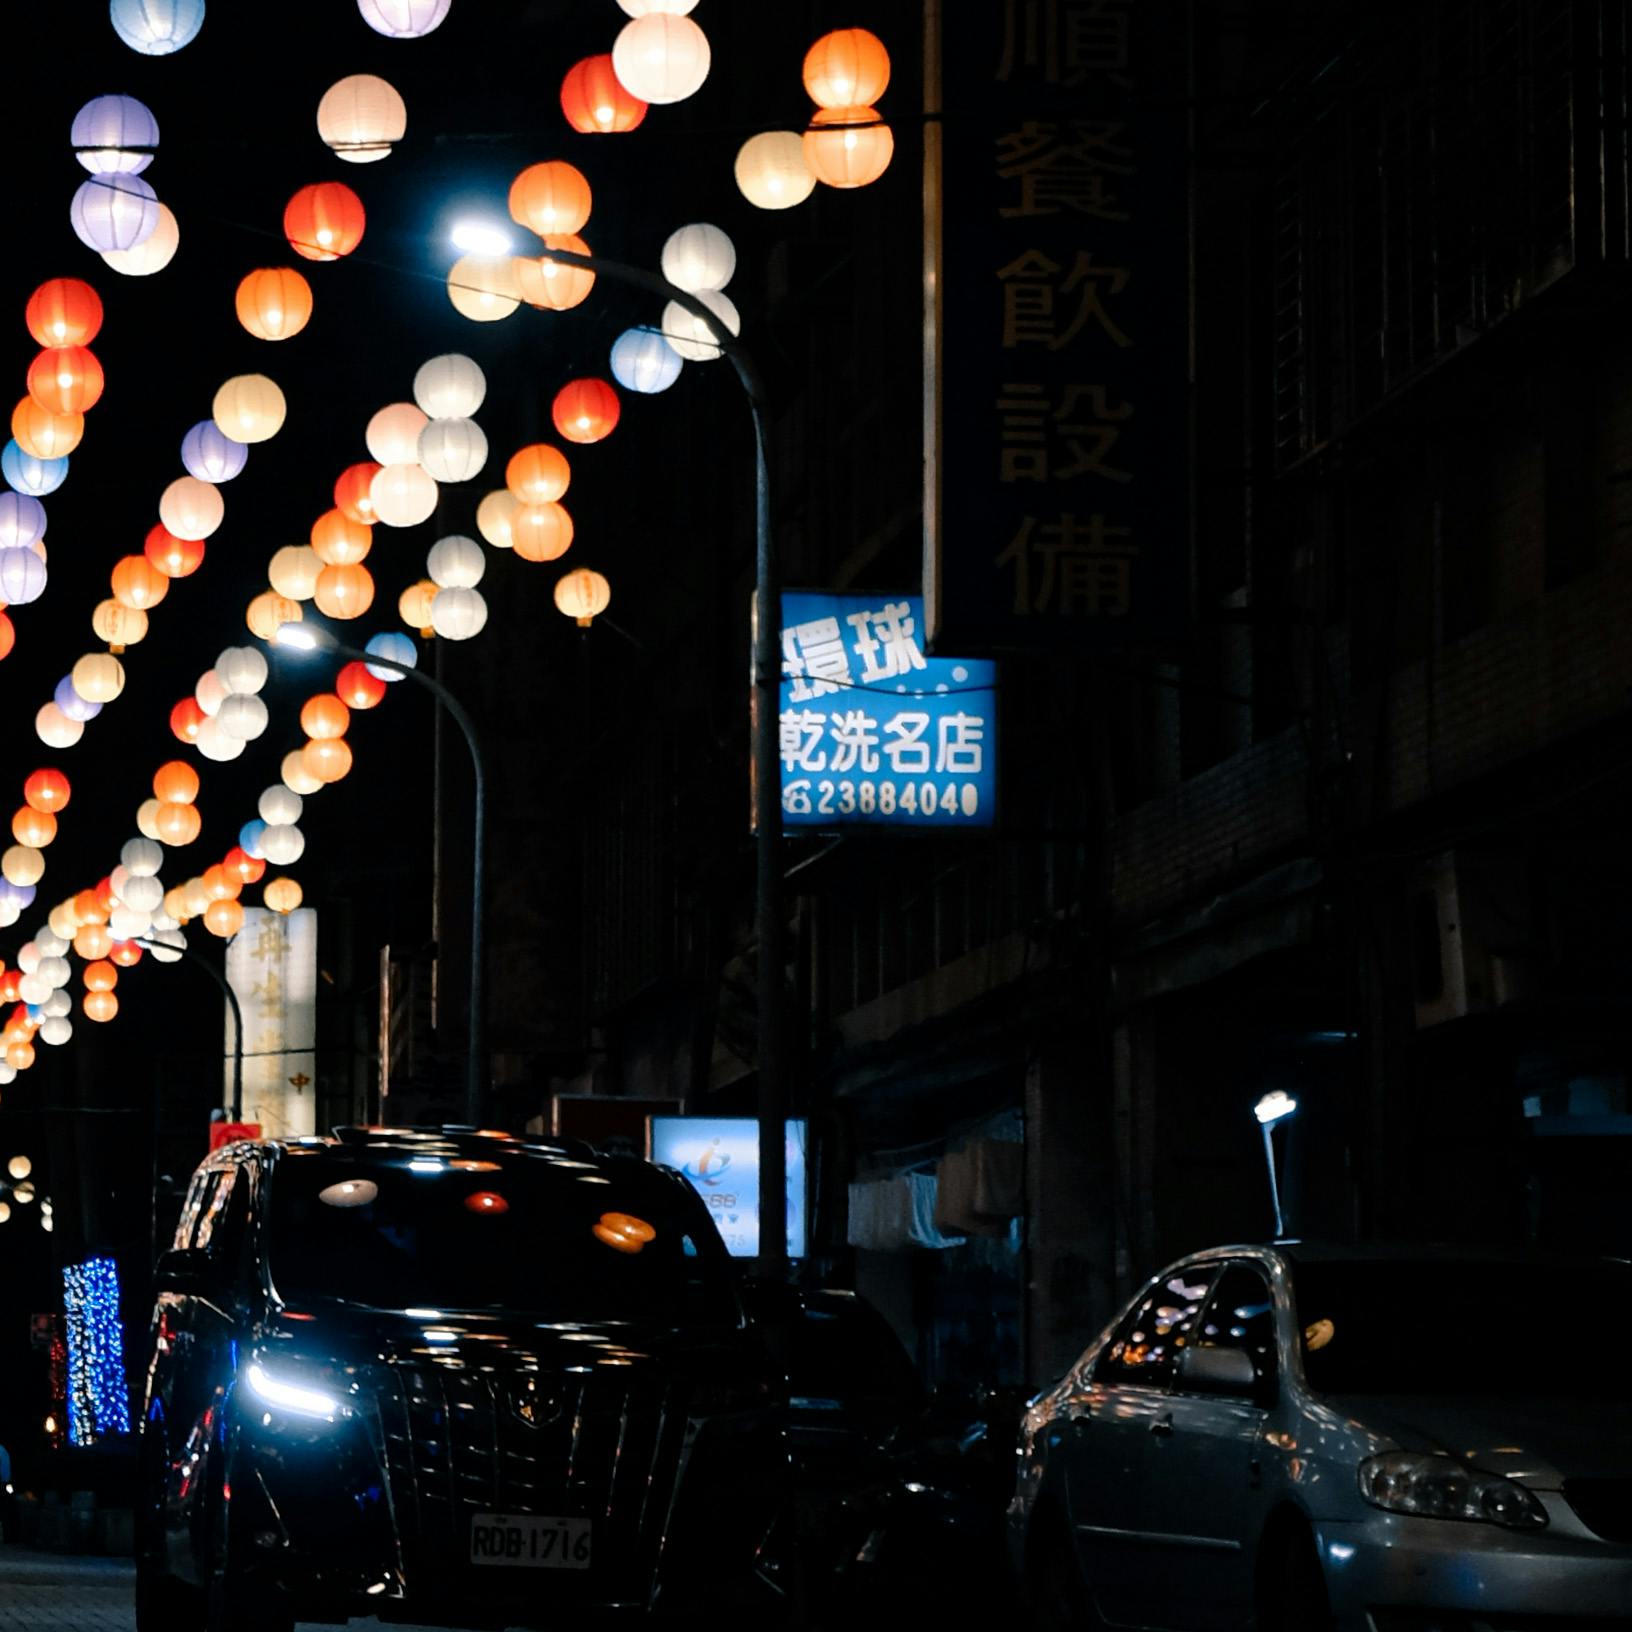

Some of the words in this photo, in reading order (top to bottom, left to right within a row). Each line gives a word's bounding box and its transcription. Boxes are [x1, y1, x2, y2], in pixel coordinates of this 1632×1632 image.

[780, 601, 927, 703] 環球
[779, 709, 985, 774] 乾洗名店
[473, 1526, 590, 1561] RDB-1716
